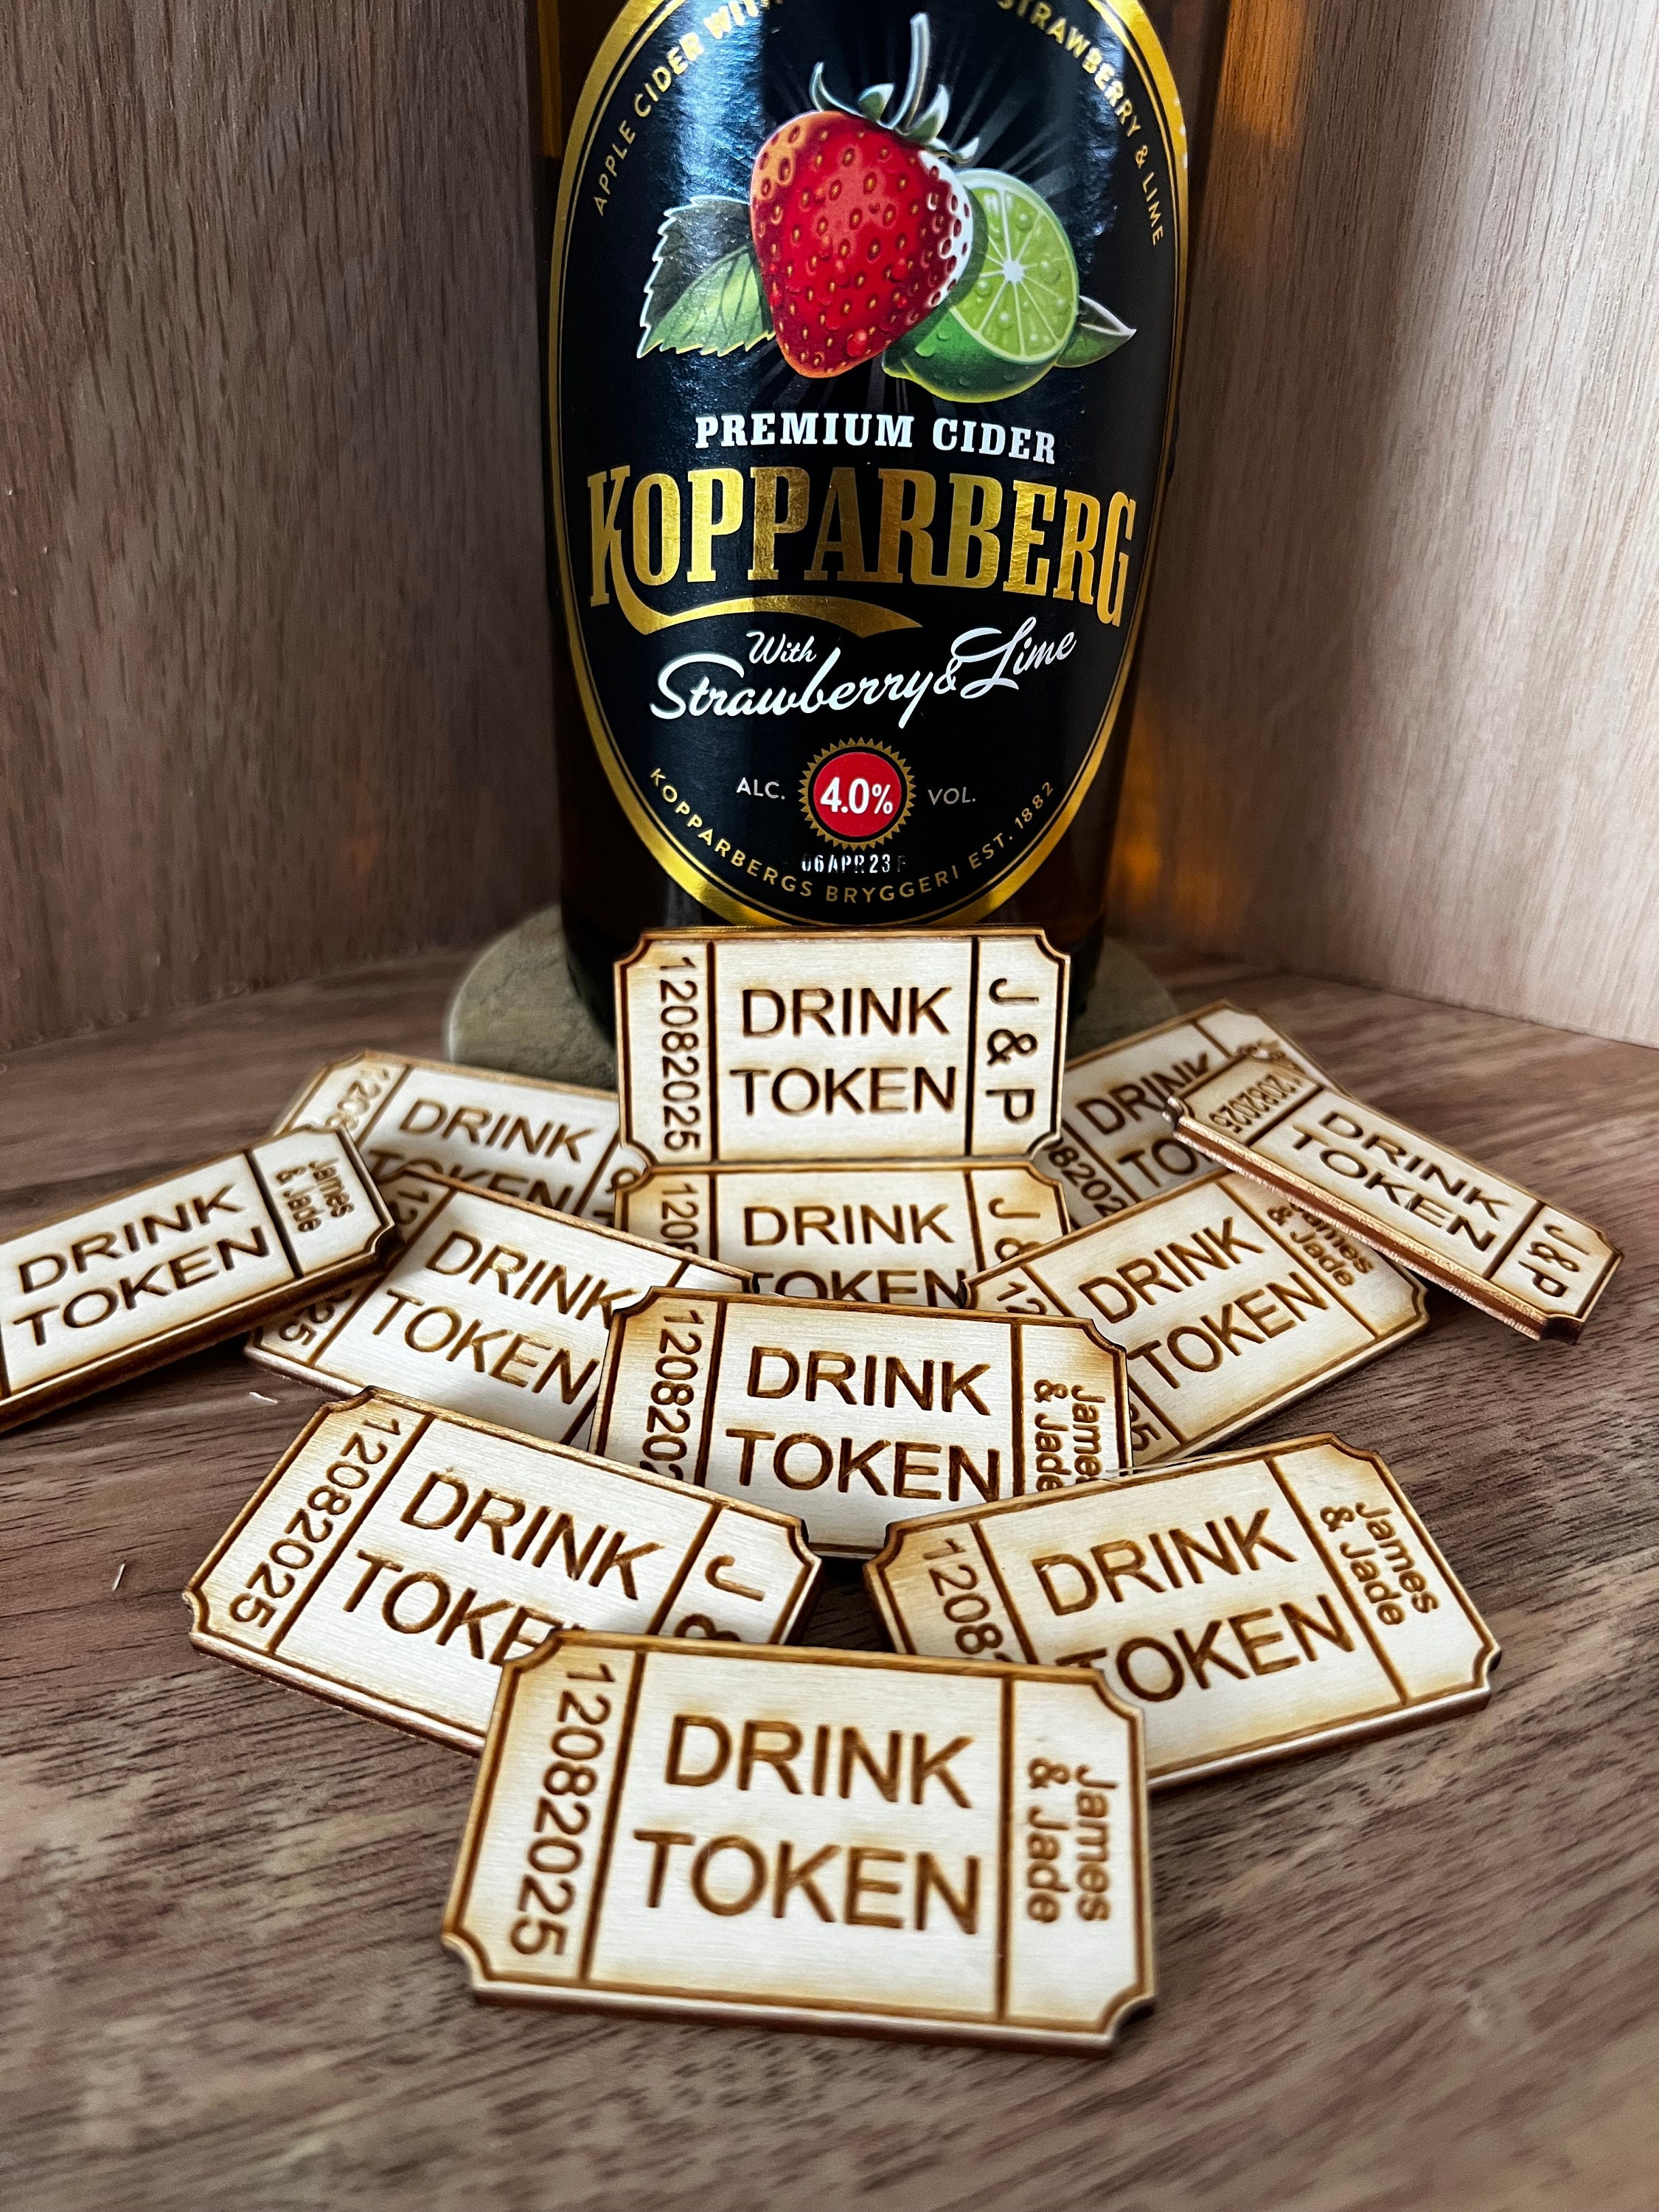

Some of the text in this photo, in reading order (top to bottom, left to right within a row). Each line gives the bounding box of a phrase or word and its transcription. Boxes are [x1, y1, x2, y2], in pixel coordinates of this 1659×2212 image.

[594, 120, 636, 216] APPLE
[633, 32, 705, 117] CIDER
[1134, 145, 1149, 169] &
[1142, 172, 1164, 246] LIME
[695, 411, 1056, 465] PREMIUM CIDER
[588, 465, 1137, 637] KOPPARBERG
[650, 647, 935, 728] Strawberry
[951, 616, 1077, 698] Lime
[746, 630, 817, 664] With
[650, 767, 1056, 903] KOPPARBERGS BRYGGERI EST. 1882
[736, 776, 976, 816] ALC. 4.0% VOL.
[659, 956, 700, 1152] 12082025
[741, 986, 953, 1037] DRINK
[986, 977, 1039, 1124] J & P
[399, 1098, 594, 1162] DRINK
[729, 1065, 956, 1116] TOKEN
[988, 1197, 1040, 1219] J
[1293, 1124, 1497, 1252] TOKEN
[1320, 1111, 1512, 1220] DRINK
[18, 1184, 243, 1295] DRINK
[425, 1230, 639, 1329] DRINK
[745, 1202, 955, 1246] DRINK
[1078, 1217, 1263, 1324] DRINK
[1267, 1206, 1354, 1286] & Jade
[1517, 1223, 1590, 1297] J & P
[13, 1225, 271, 1346] TOKEN
[1127, 1272, 1329, 1390] TOKEN
[372, 1289, 599, 1405] TOKEN
[639, 1310, 706, 1481] 120820
[746, 1346, 991, 1416] DRINK
[726, 1428, 1000, 1501] TOKEN
[1034, 1380, 1071, 1492] & Jade
[230, 1418, 400, 1628] 12082025
[400, 1467, 664, 1601] DRINK
[705, 1554, 765, 1601] J
[1032, 1508, 1296, 1615] DRINK
[1320, 1504, 1406, 1627] & Jade
[1355, 1502, 1439, 1615] James
[343, 1550, 565, 1666] TOKE
[923, 1537, 1012, 1662] 1208
[509, 1662, 615, 1956] 12082025
[664, 1714, 972, 1808] DRINK
[633, 1829, 979, 1935] TOKEN
[1027, 1756, 1071, 1924] & Jade
[1075, 1764, 1117, 1922] James
